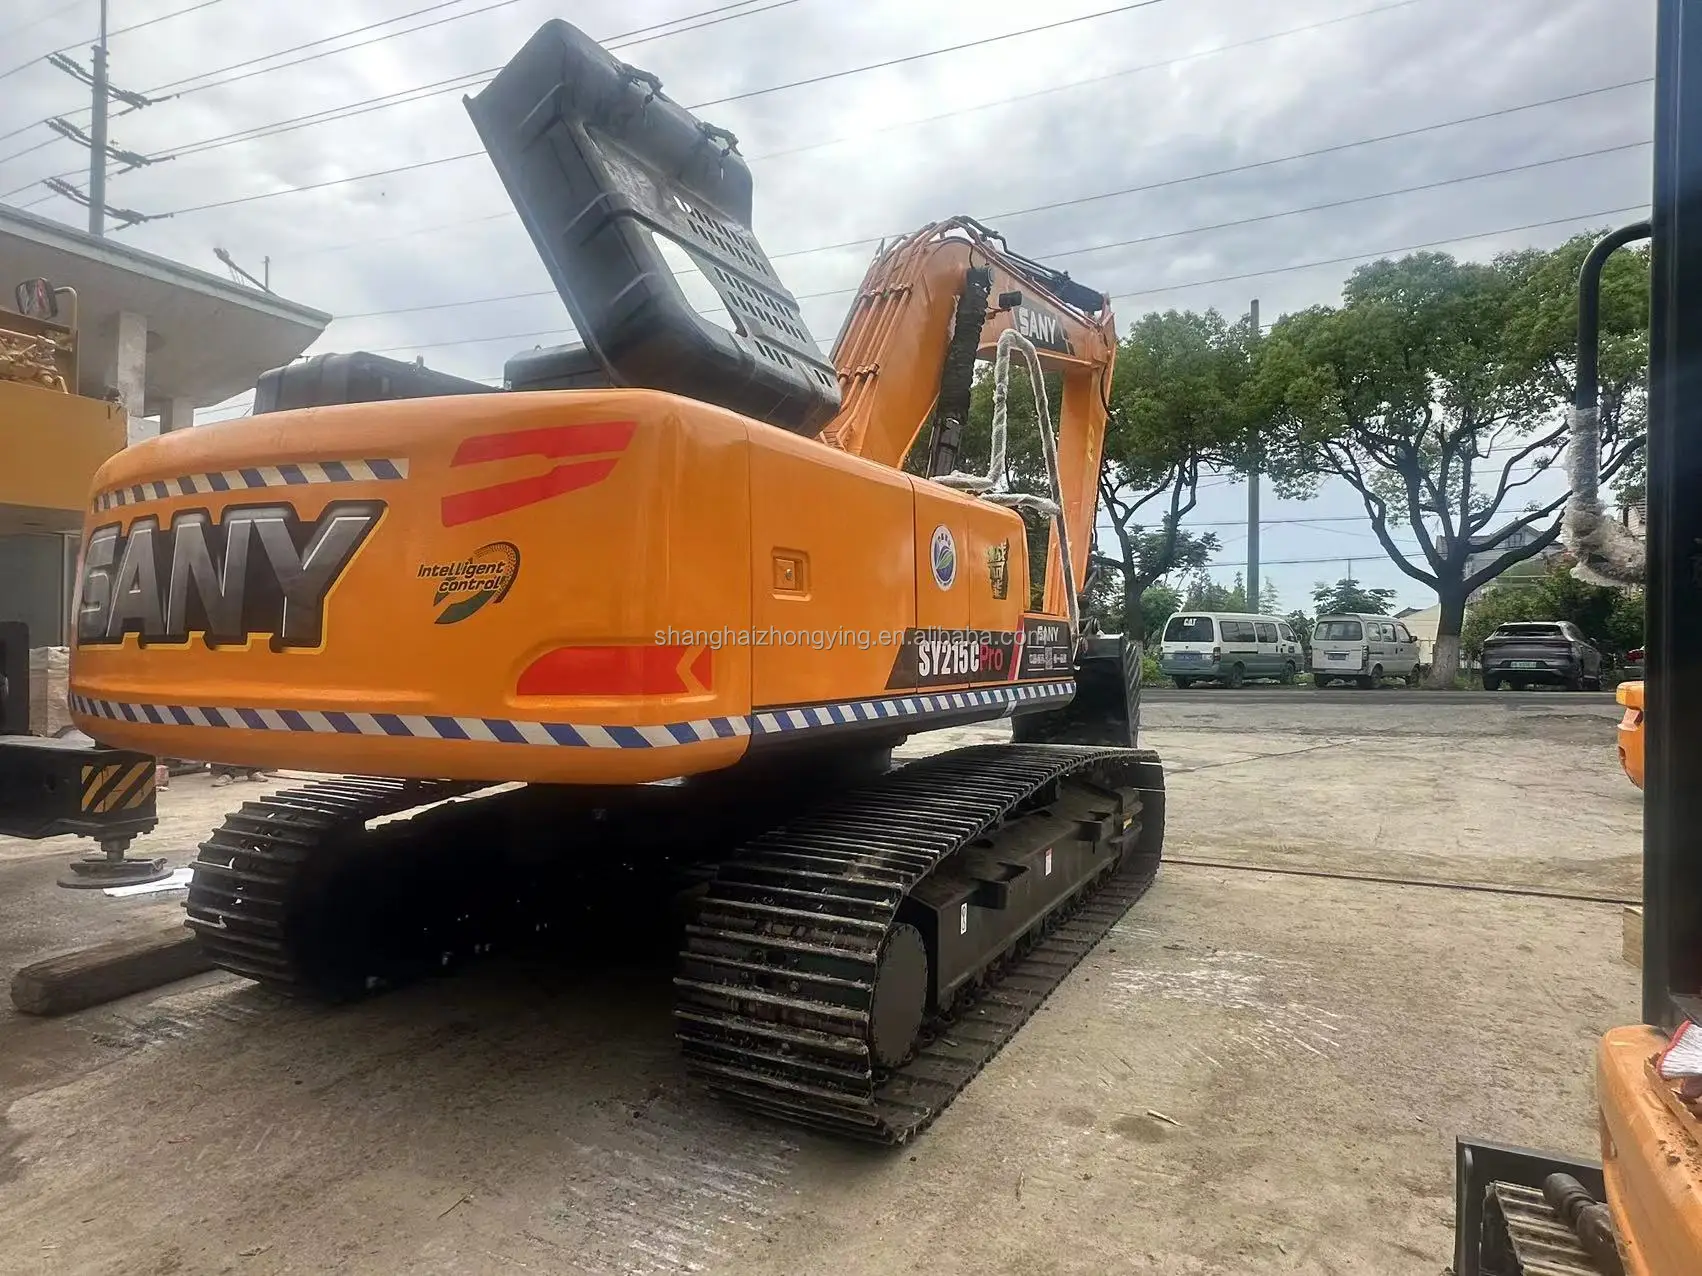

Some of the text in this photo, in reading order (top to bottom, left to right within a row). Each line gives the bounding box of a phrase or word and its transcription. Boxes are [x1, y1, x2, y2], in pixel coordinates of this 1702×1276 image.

[1018, 306, 1057, 345] SANY
[77, 499, 389, 652] SANY
[417, 558, 505, 578] Intelligent
[439, 576, 501, 591] control
[1183, 617, 1198, 627] CAT
